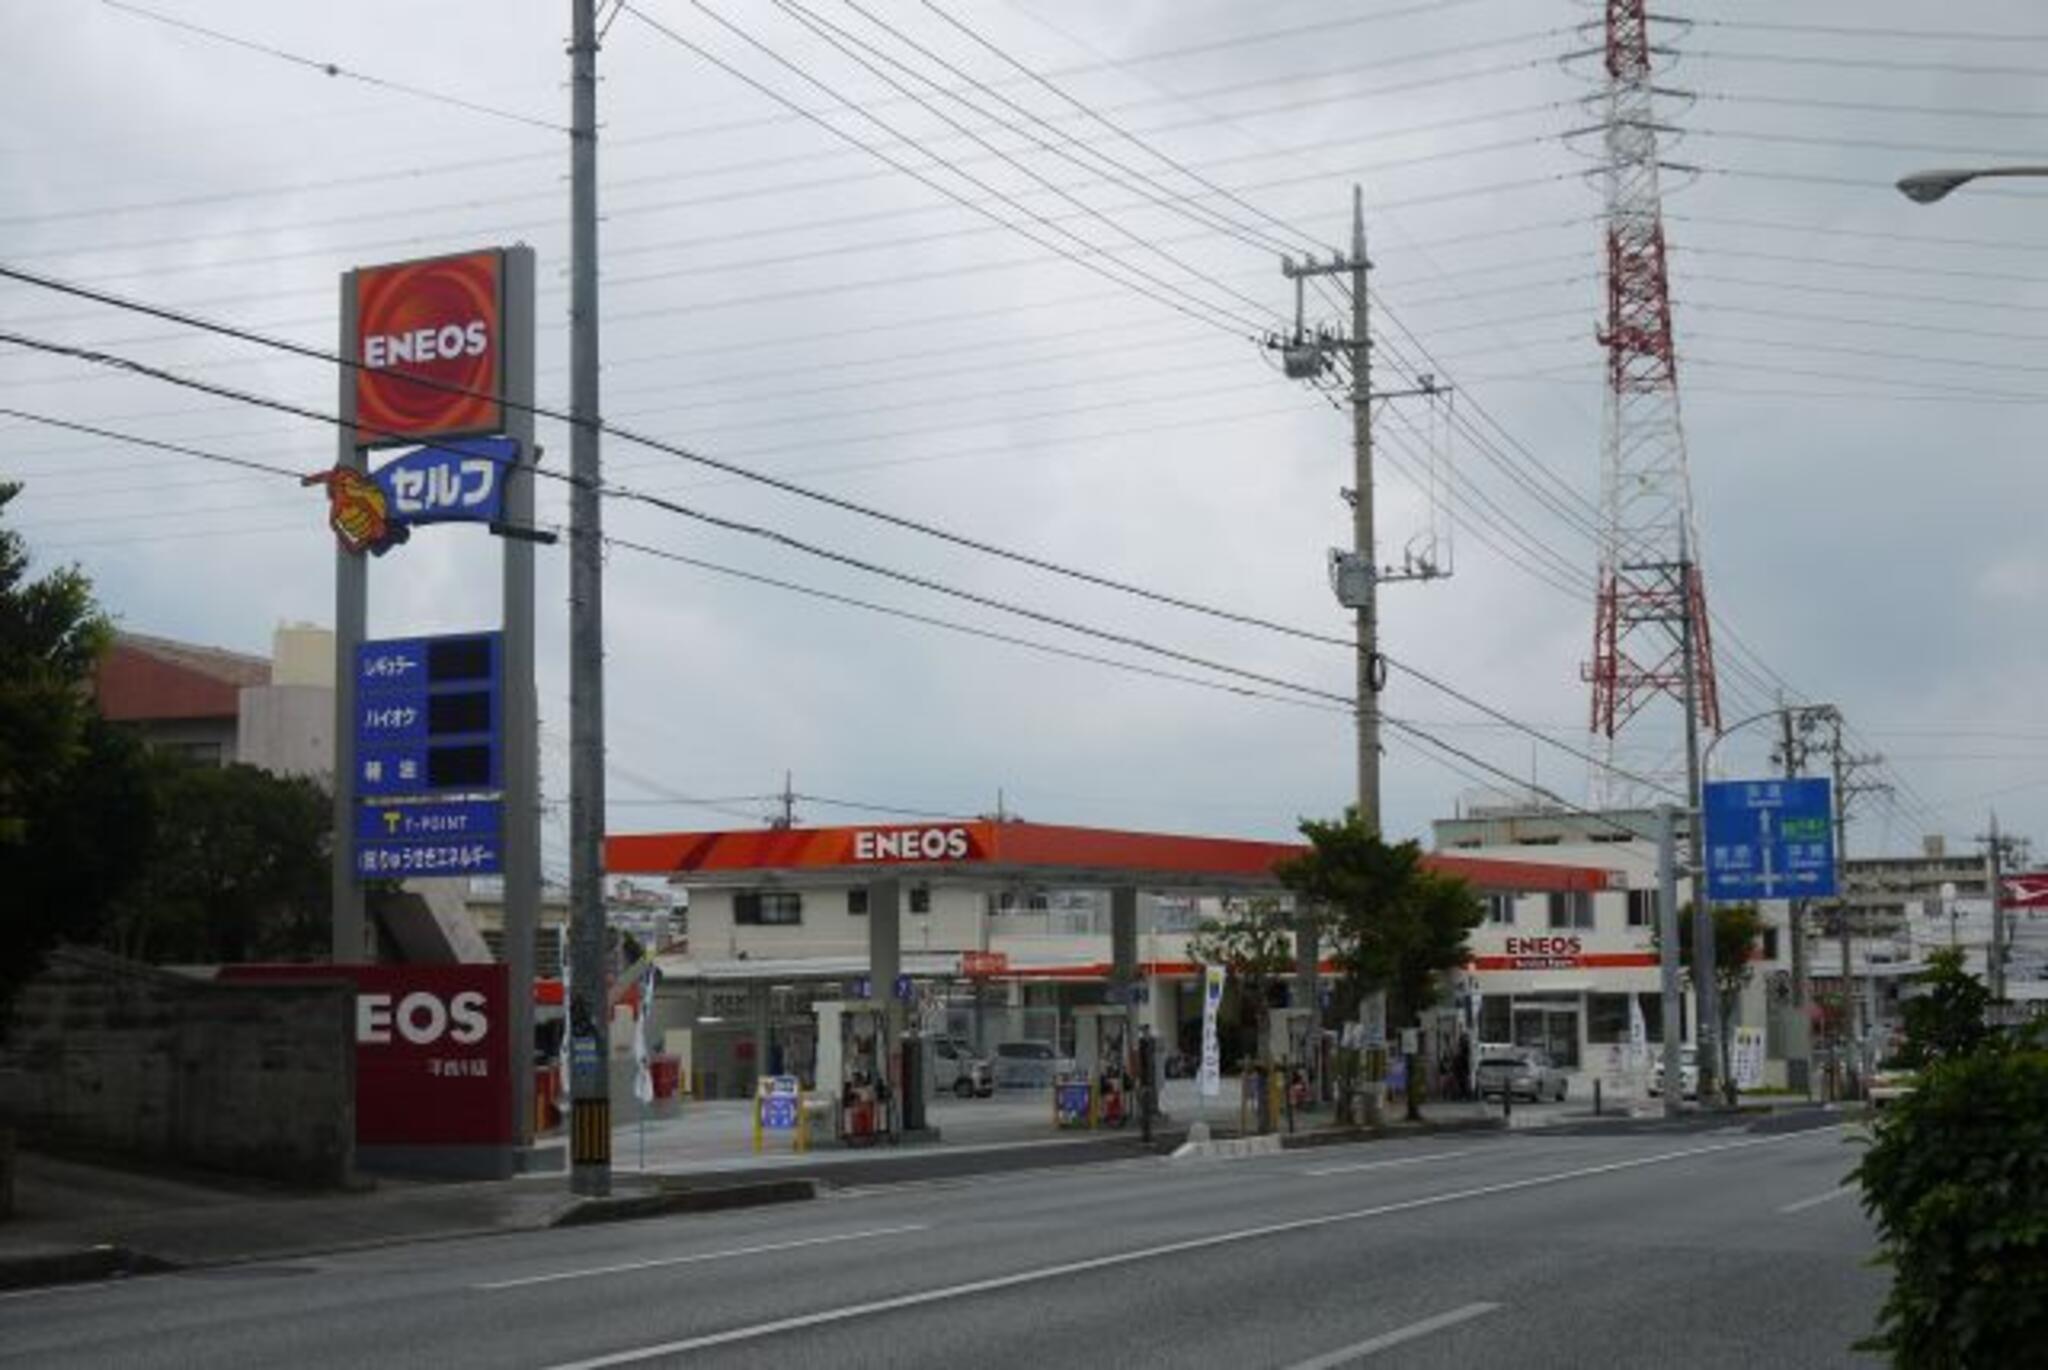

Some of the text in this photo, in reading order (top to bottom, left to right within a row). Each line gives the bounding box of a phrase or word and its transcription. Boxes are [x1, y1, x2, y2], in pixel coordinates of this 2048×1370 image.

[364, 320, 487, 369] ENEOS
[389, 460, 494, 511] セルフ
[362, 656, 417, 676] レギュラー
[366, 706, 416, 728] ハイオク
[854, 828, 968, 859] ENEOS
[1505, 937, 1582, 955] ENEOS
